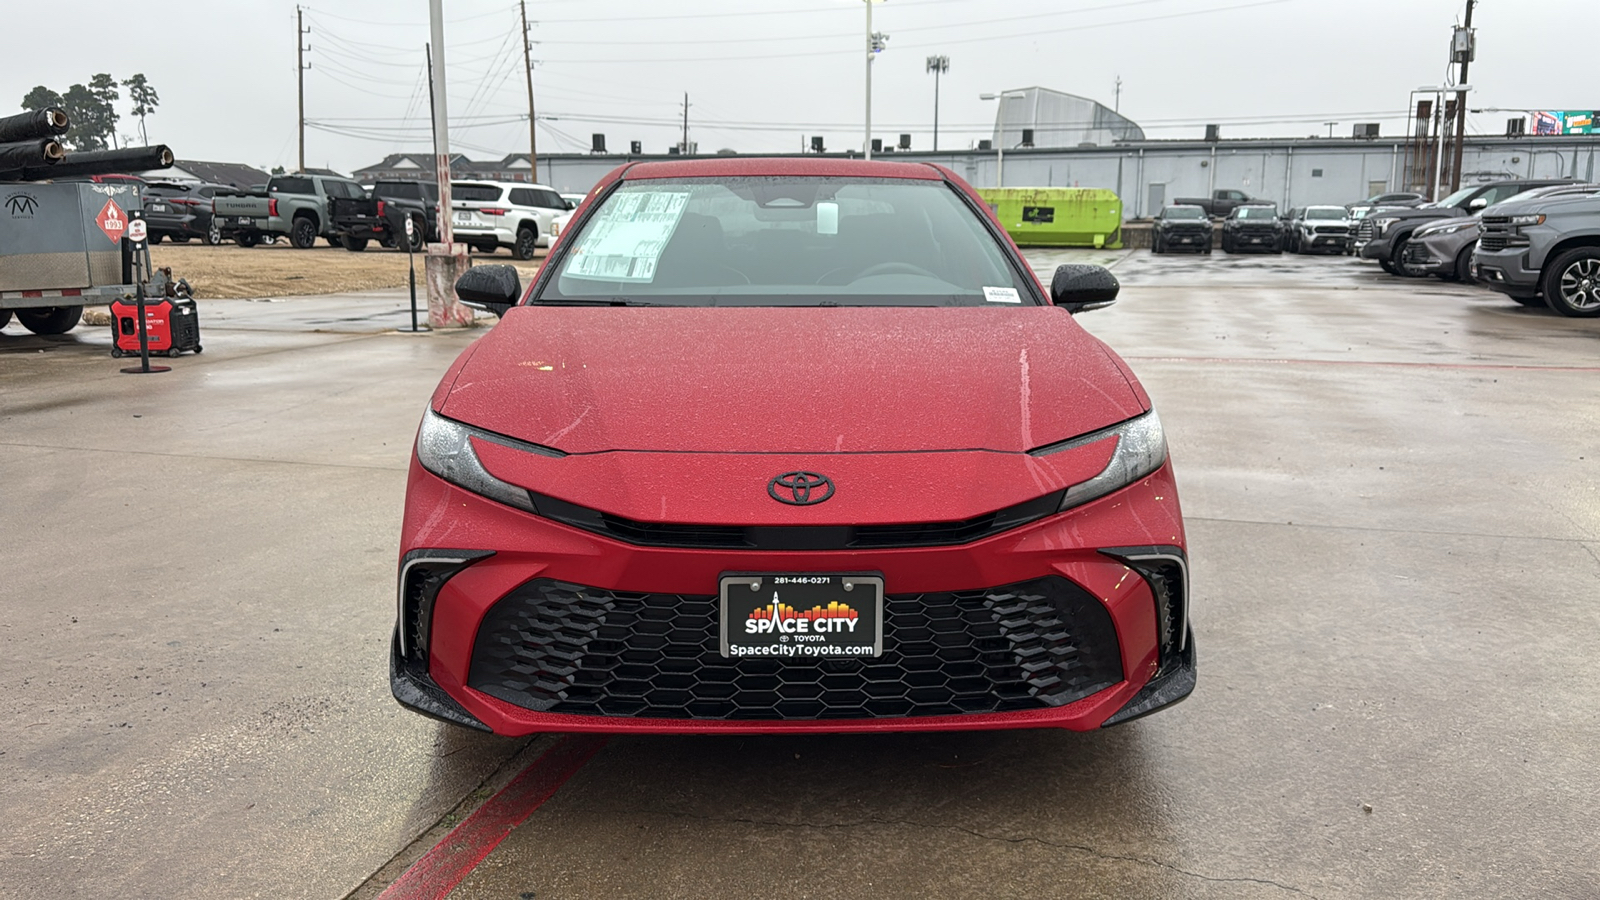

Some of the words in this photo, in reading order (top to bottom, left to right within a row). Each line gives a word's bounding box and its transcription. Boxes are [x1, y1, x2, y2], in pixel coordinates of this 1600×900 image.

[105, 221, 122, 229] 1993
[745, 618, 809, 633] SPACE
[813, 617, 859, 633] CITY
[730, 644, 873, 657] SpaceCityToyota.com
